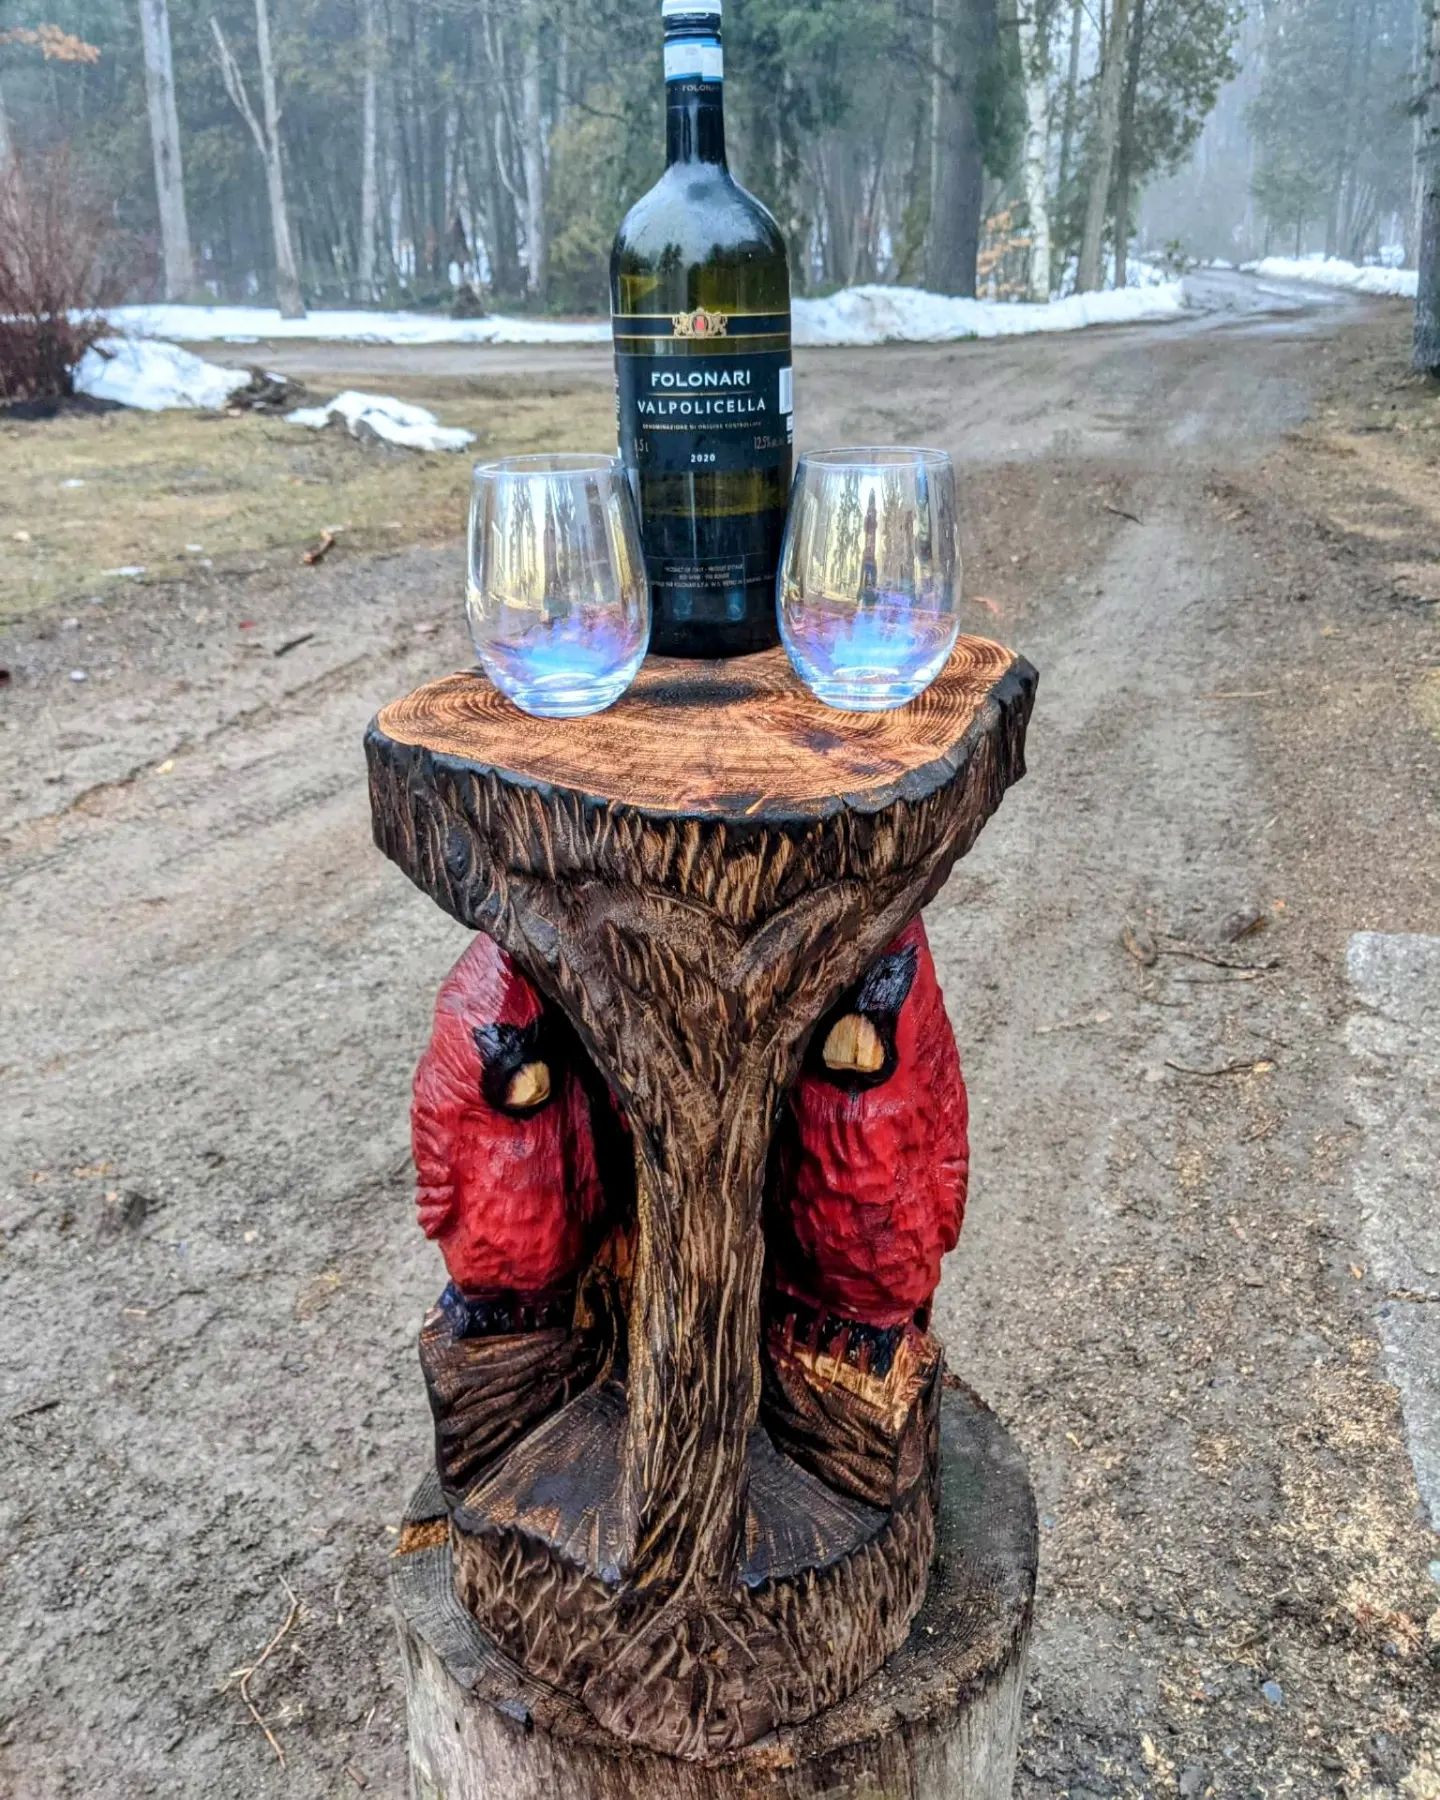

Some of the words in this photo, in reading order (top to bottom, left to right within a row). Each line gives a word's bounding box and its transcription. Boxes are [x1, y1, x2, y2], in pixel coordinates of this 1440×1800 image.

[651, 370, 751, 387] FOLONARI
[637, 398, 766, 415] VALPOLICELLA
[691, 454, 715, 463] 2020
